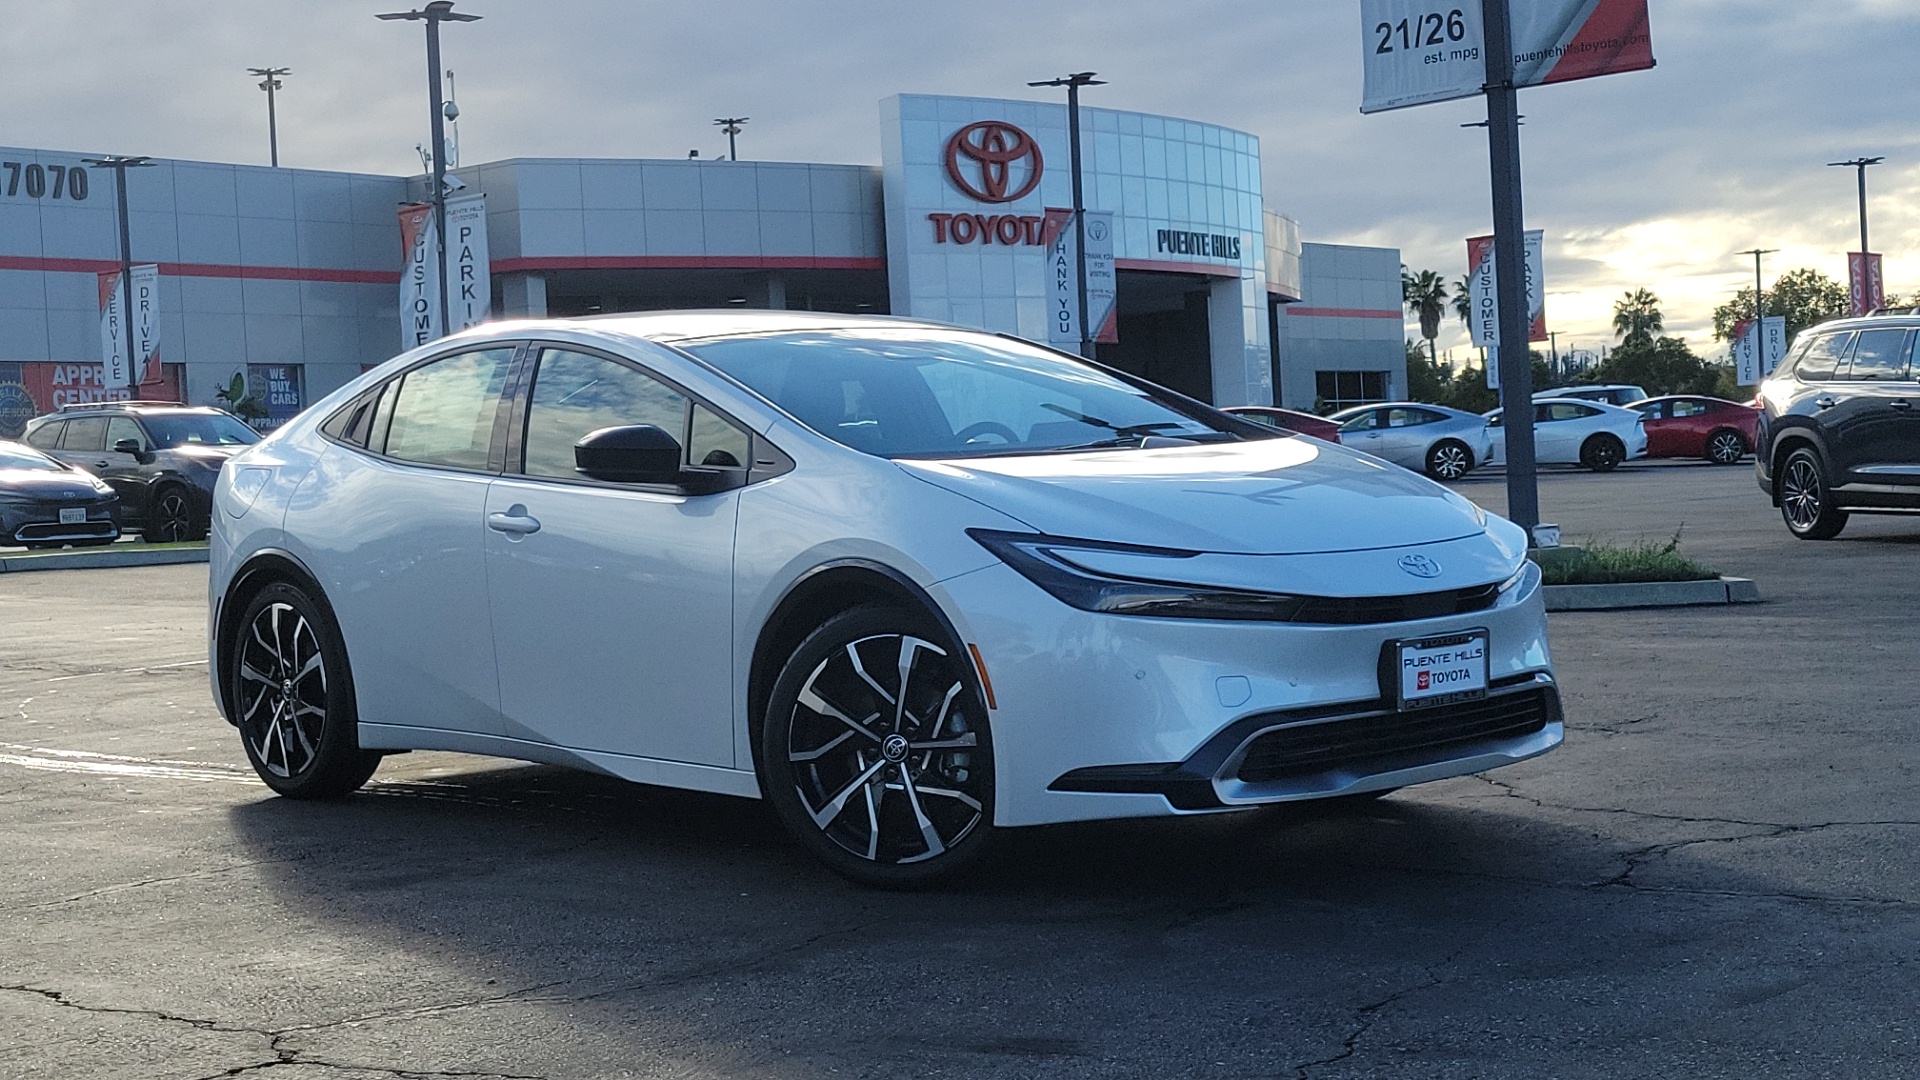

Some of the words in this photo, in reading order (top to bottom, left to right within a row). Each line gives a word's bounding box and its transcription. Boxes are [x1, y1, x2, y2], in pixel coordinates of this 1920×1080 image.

[1375, 9, 1465, 54] 21/26
[1424, 51, 1447, 64] est.
[1450, 47, 1479, 61] mpg
[0, 162, 89, 200] 7070
[1056, 231, 1067, 291] THANK
[1157, 229, 1211, 256] PUENTE
[1211, 234, 1241, 260] HILLS
[1480, 254, 1494, 341] CUSTOMER
[141, 287, 150, 352] DRIVE
[1058, 298, 1070, 333] YOU
[109, 290, 120, 379] SERVICE
[1770, 328, 1779, 369] DRIVE
[269, 368, 286, 380] WE
[270, 380, 291, 392] BUY
[271, 393, 298, 405] CARS
[1404, 653, 1450, 668] PUENTE
[1455, 648, 1483, 661] HILLS
[1431, 669, 1471, 684] TOYOTA
